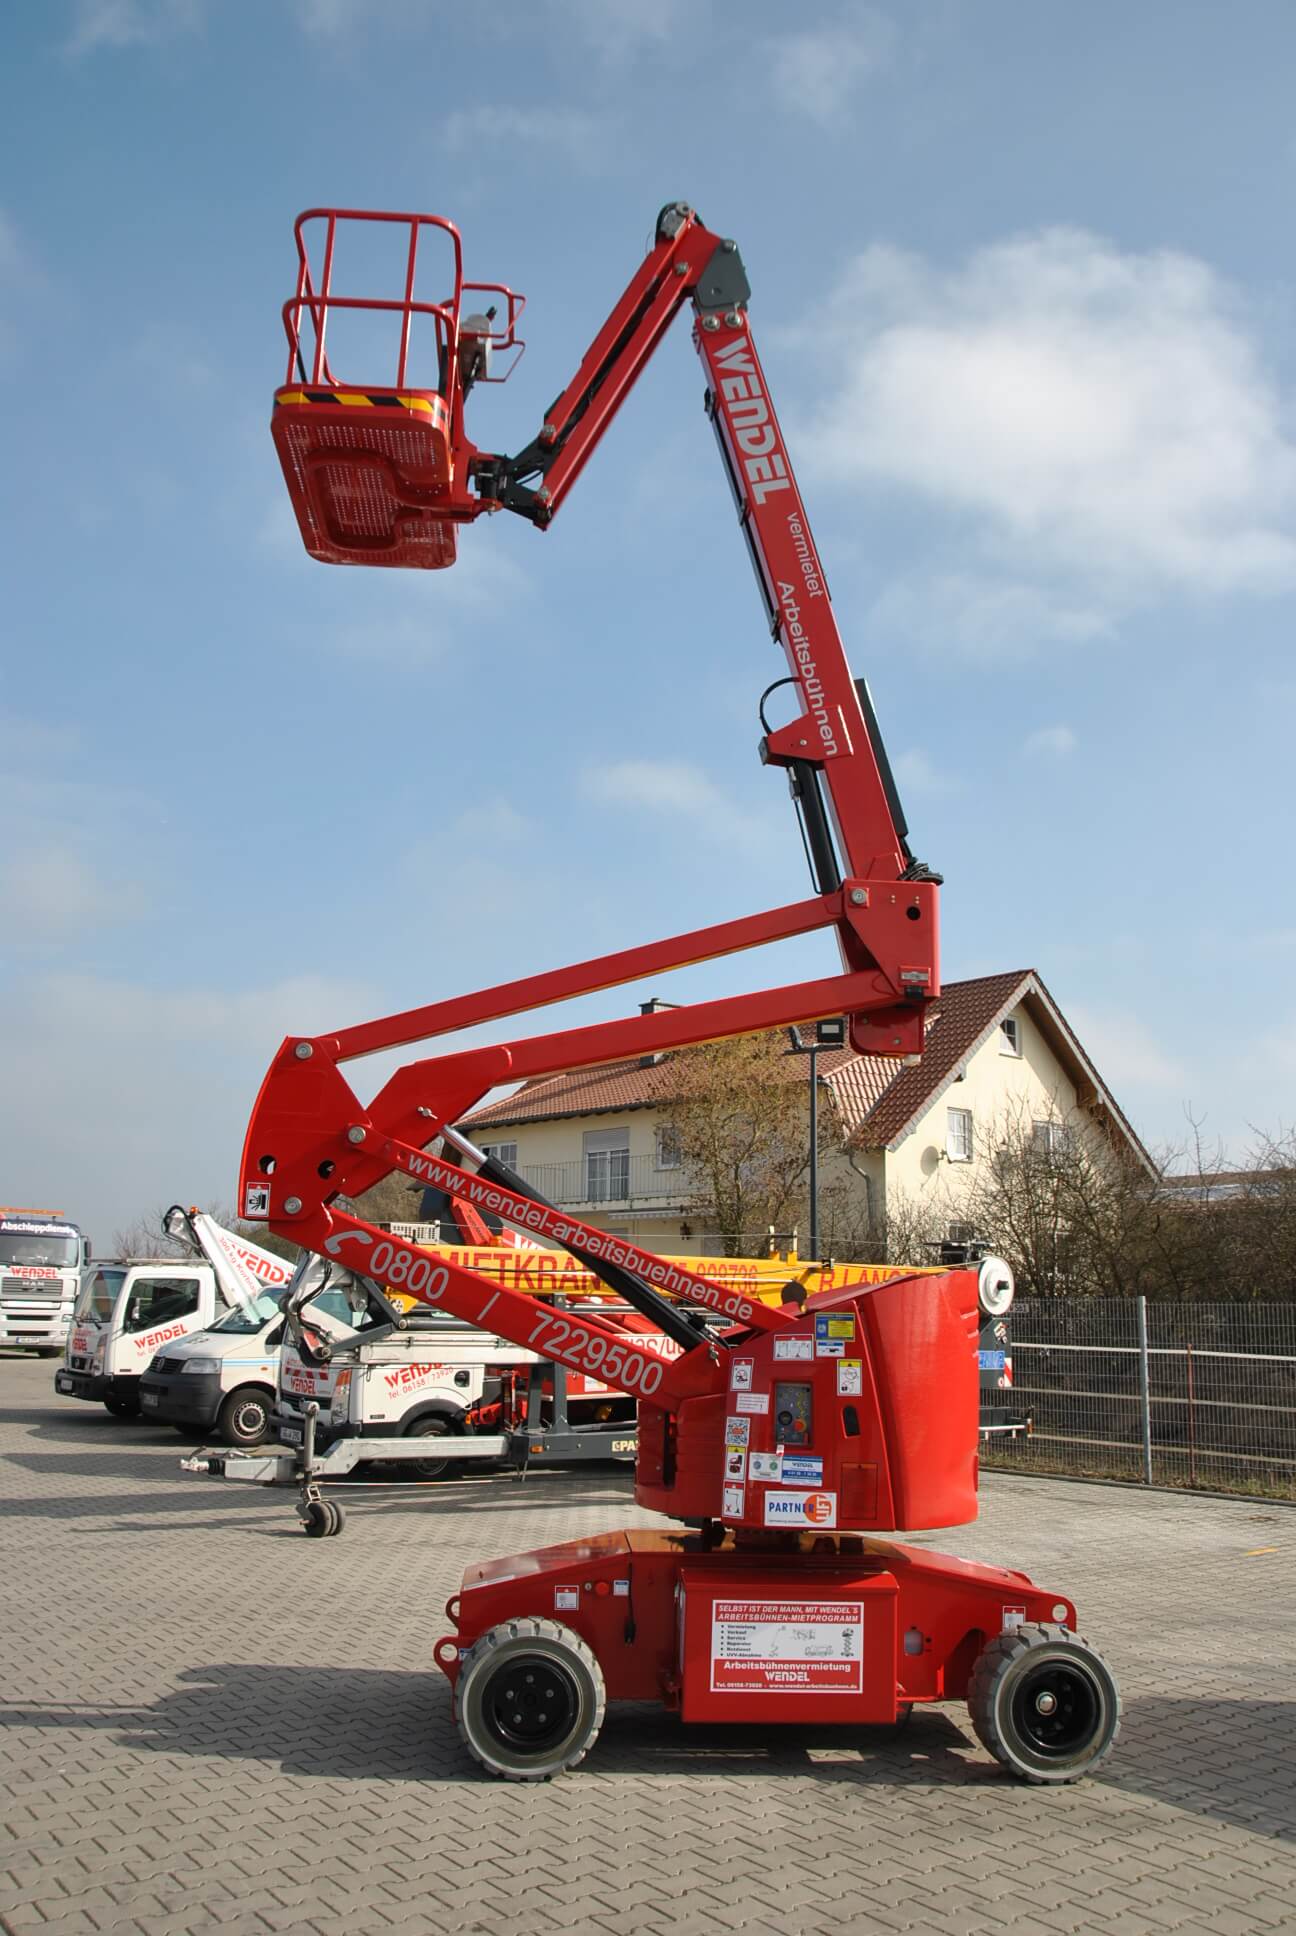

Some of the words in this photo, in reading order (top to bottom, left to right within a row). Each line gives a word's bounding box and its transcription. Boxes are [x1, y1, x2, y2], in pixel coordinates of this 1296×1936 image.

[713, 336, 792, 505] WENDEL
[786, 512, 824, 599] vermietet
[777, 581, 838, 756] Arbeitsbühnen
[408, 1153, 754, 1321] www.wendel-arbeitsbuehnen.de
[10, 1267, 58, 1278] WENDEL
[369, 1241, 450, 1301] 0800
[526, 1310, 664, 1396] 7229500
[134, 1324, 188, 1349] WENDEL
[291, 1376, 316, 1395] WENDEL
[769, 1502, 815, 1514] PARTNER
[718, 1613, 859, 1622] ARBEITSBÜHNEN-MIETPROGRAMM
[724, 1661, 851, 1673] Arbeitsbühnenvermietung
[764, 1671, 810, 1682] WENDEL
